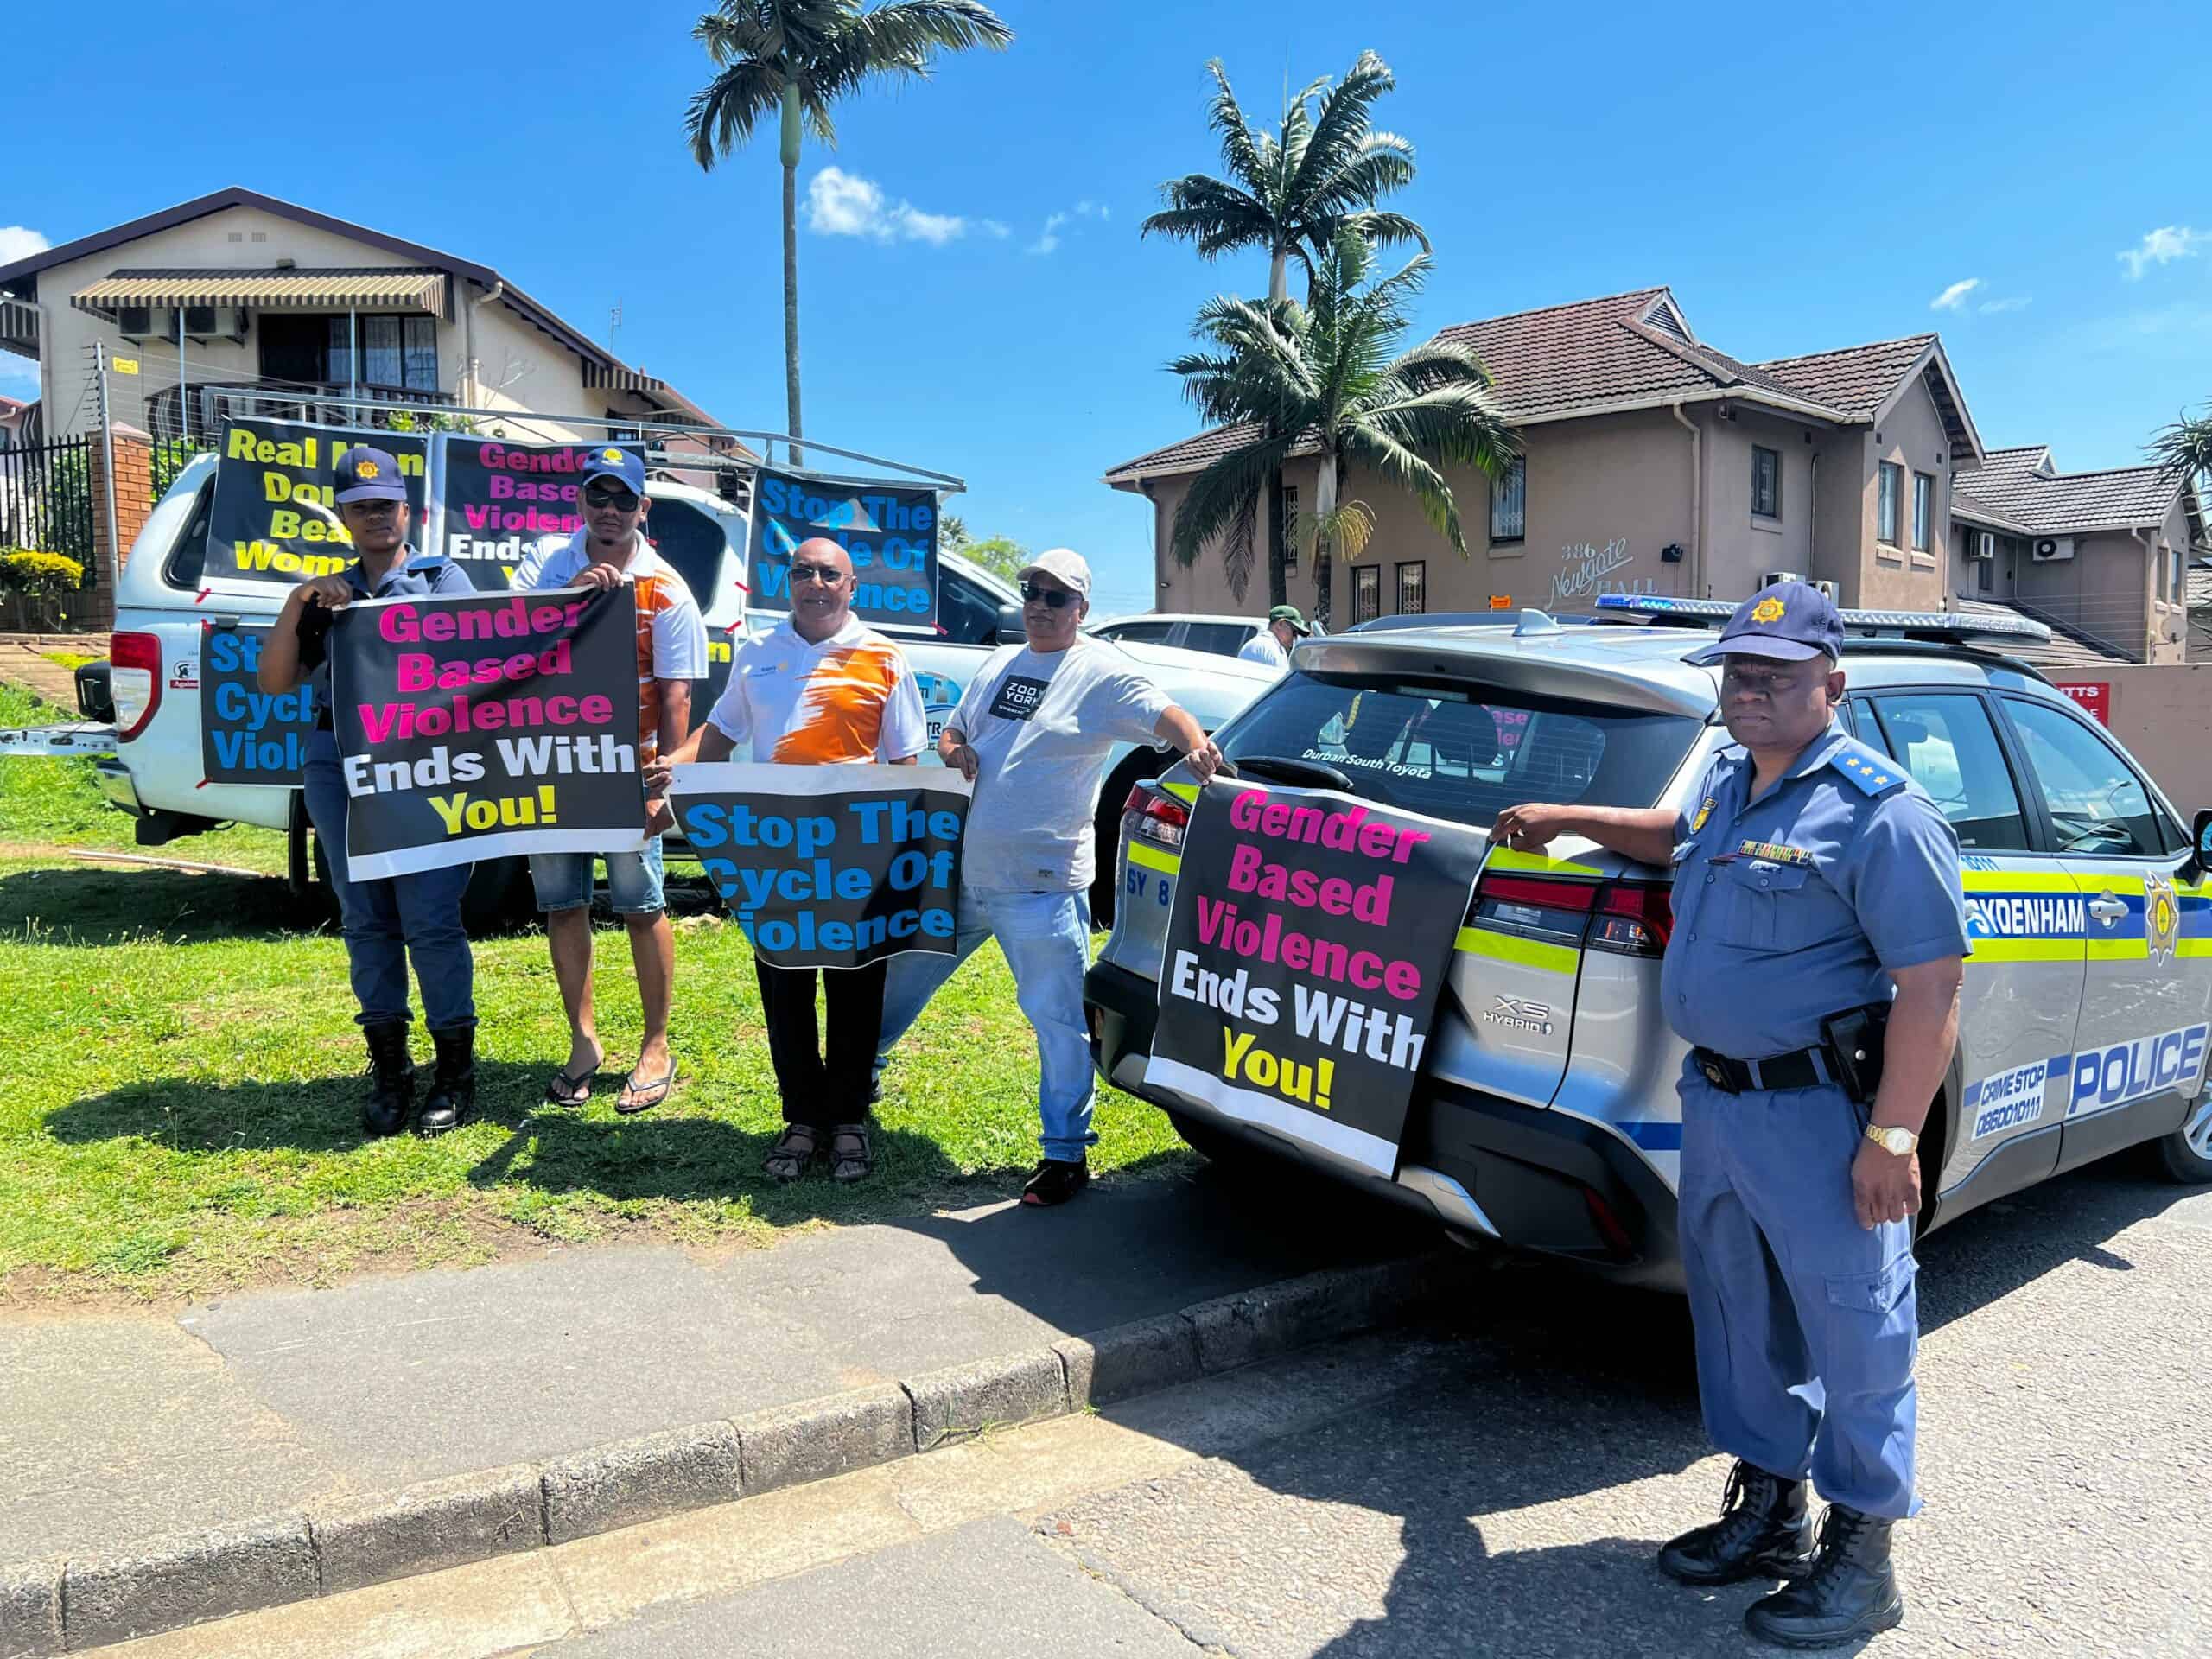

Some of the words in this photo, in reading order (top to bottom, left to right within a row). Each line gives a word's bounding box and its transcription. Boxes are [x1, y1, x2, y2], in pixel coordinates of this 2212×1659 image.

[228, 428, 318, 469] Real
[479, 443, 590, 473] Gend
[490, 474, 579, 502] Base
[760, 478, 855, 530] Stop
[862, 495, 933, 531] The
[464, 503, 585, 533] Violen
[234, 541, 360, 576] Wom
[882, 537, 929, 573] Of
[1597, 577, 1658, 596] HALL
[379, 596, 588, 643] Gender
[397, 639, 573, 692] Based
[1007, 682, 1038, 696] ZOO
[217, 682, 313, 731] Cycl
[358, 694, 613, 744] Violence
[344, 746, 486, 798] Ends
[495, 734, 636, 776] With
[1301, 748, 1344, 764] Durban
[1346, 754, 1383, 770] South
[1386, 760, 1432, 779] Toyota
[427, 785, 557, 836] You!
[685, 803, 836, 858] Stop
[849, 800, 960, 844] The
[1230, 789, 1432, 864] Gender
[701, 858, 872, 911] Cycle
[889, 849, 954, 892] Of
[1227, 843, 1394, 926] Based
[738, 907, 956, 951] iolence
[1965, 899, 2086, 935] SYDENHAM
[1198, 895, 1421, 1001] Violence
[1171, 949, 1281, 1026] Ends
[1294, 983, 1427, 1072] With
[1483, 1010, 1541, 1034] HYBRID
[1223, 1026, 1335, 1111] You!
[2014, 1065, 2045, 1094] STOP
[2068, 1025, 2208, 1116] POLICE
